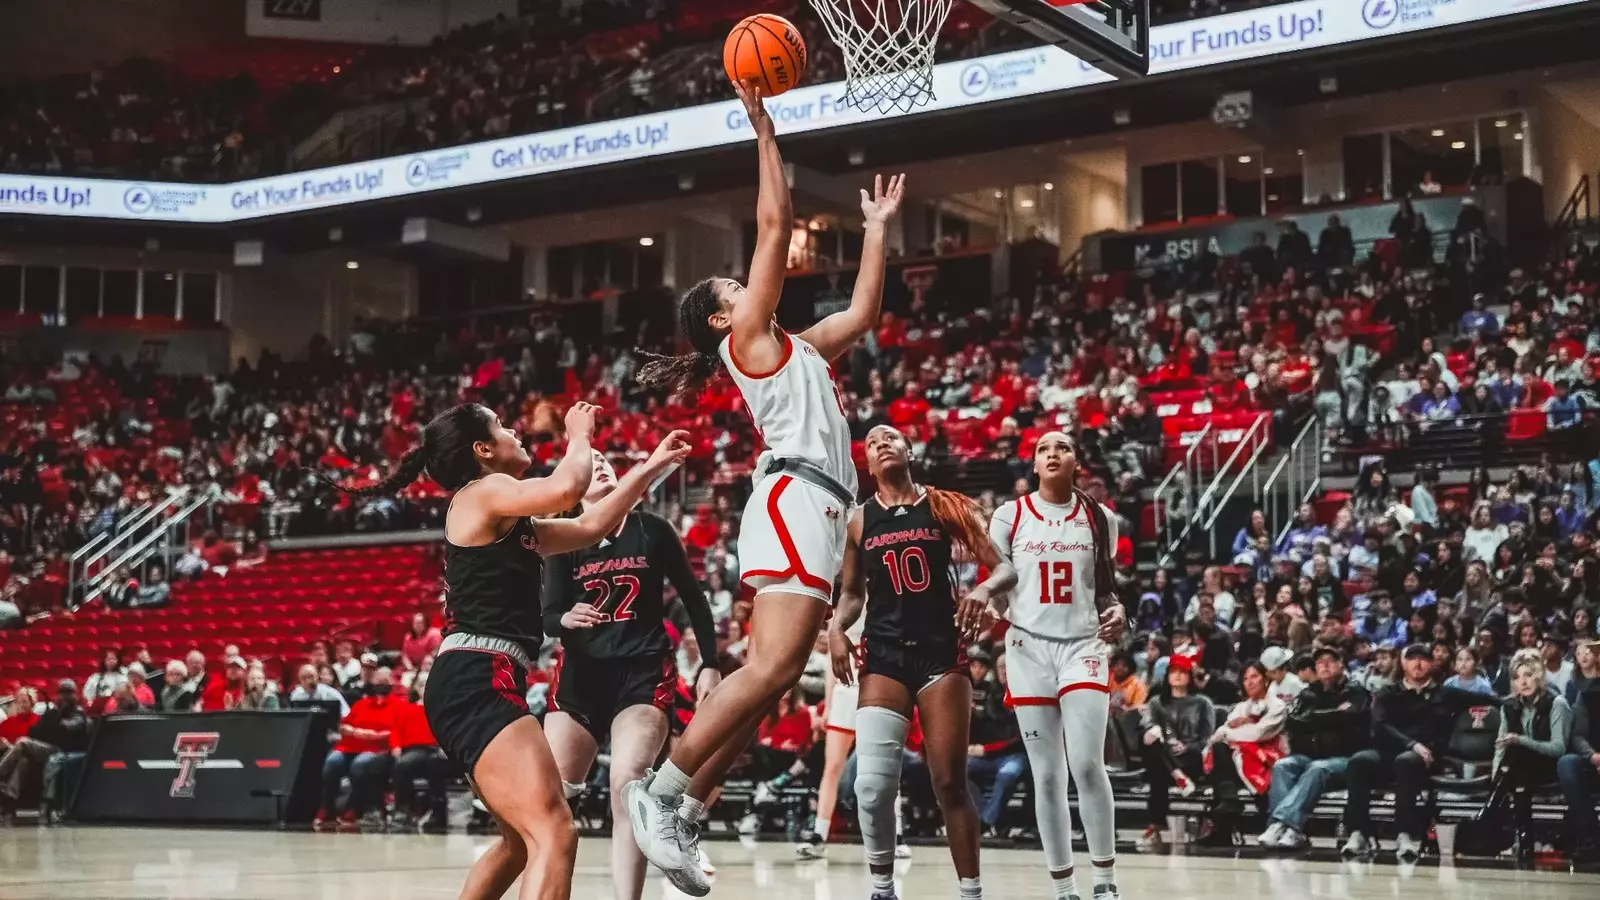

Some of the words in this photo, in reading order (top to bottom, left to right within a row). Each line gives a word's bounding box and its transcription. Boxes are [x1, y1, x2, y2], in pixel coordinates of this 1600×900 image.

[1149, 40, 1185, 60] our
[1191, 21, 1272, 53] Funds
[1278, 9, 1324, 40] Up!
[769, 102, 813, 121] Your
[492, 148, 522, 169] Get
[529, 142, 570, 164] Your
[574, 130, 632, 156] Funds
[636, 121, 669, 148] Up!
[53, 185, 91, 209] Up!
[231, 189, 258, 210] Get
[263, 185, 298, 207] Your
[303, 175, 350, 199] Funds
[355, 168, 384, 193] Up!
[863, 528, 942, 551] CARDINALS
[1023, 540, 1047, 556] Lady
[882, 546, 931, 595] 10
[1039, 561, 1073, 604] 12
[583, 574, 637, 621] 22
